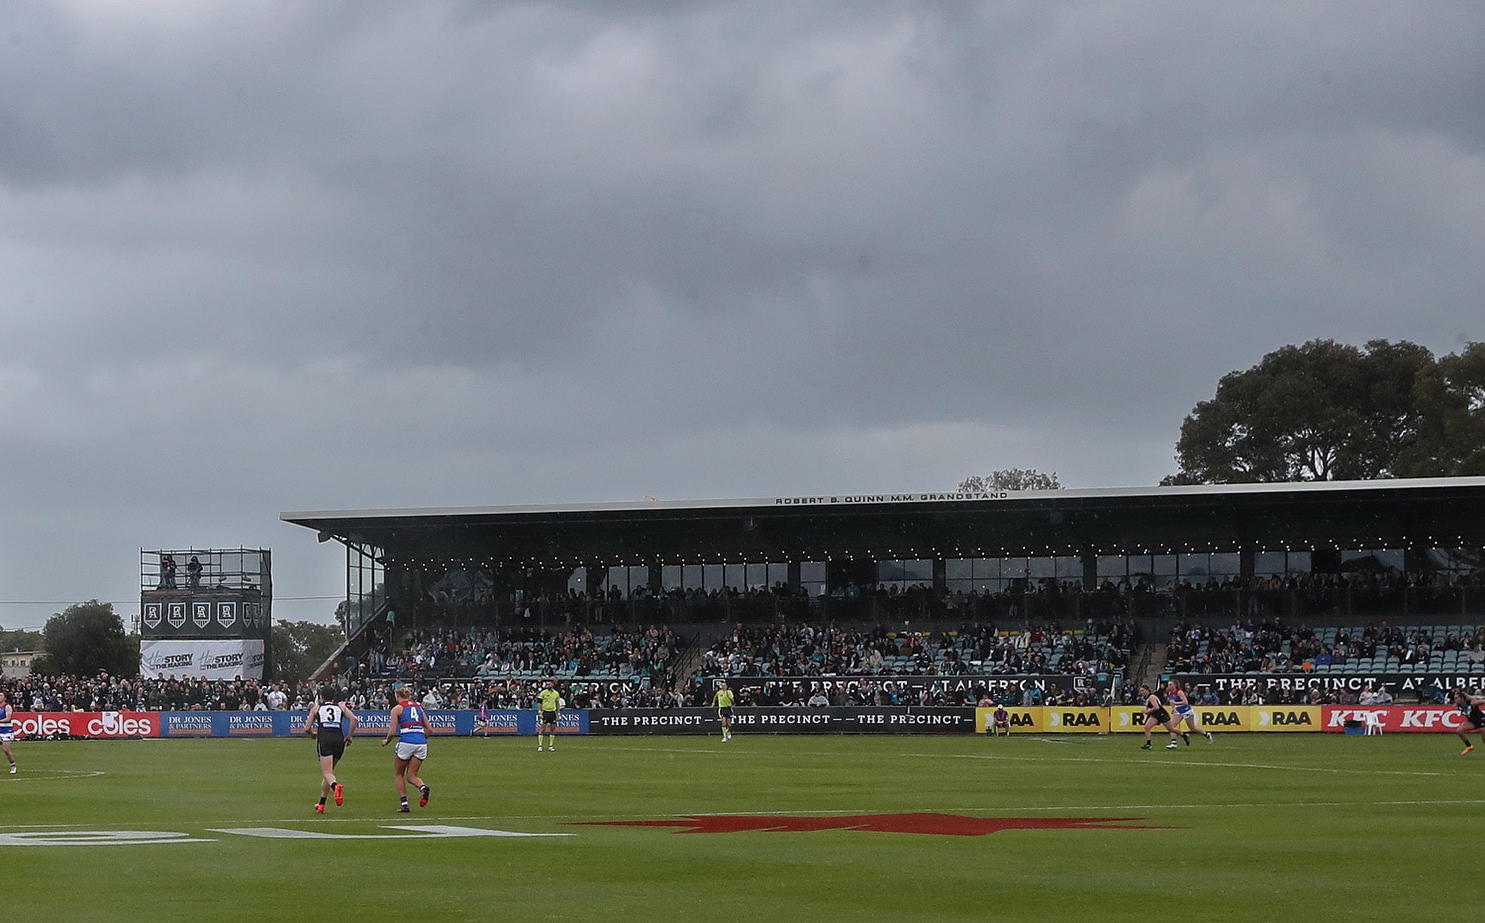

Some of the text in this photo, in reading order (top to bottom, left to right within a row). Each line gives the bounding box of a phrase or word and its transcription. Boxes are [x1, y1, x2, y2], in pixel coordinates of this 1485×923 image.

[775, 497, 824, 505] ROBERT
[845, 495, 884, 503] QUINN
[891, 494, 915, 502] M.M.
[920, 491, 1009, 501] GRANDSTAND
[1215, 678, 1257, 690] THE
[1267, 677, 1377, 690] PRECINCT
[244, 715, 272, 723] JONES
[326, 707, 335, 722] 3
[410, 706, 419, 722] 4
[428, 714, 456, 722] JONES
[490, 714, 518, 722] JONES
[602, 715, 702, 726] THE PRECINCT
[730, 715, 830, 724] THE PRECINCT
[857, 715, 961, 725] THE PRECINCT
[1010, 713, 1034, 726] AA
[1063, 713, 1100, 726] RAA
[1202, 712, 1241, 725] RAA
[1272, 711, 1312, 725] RAA
[1400, 710, 1462, 727] KFC
[11, 714, 70, 736] coles
[87, 714, 152, 735] coles
